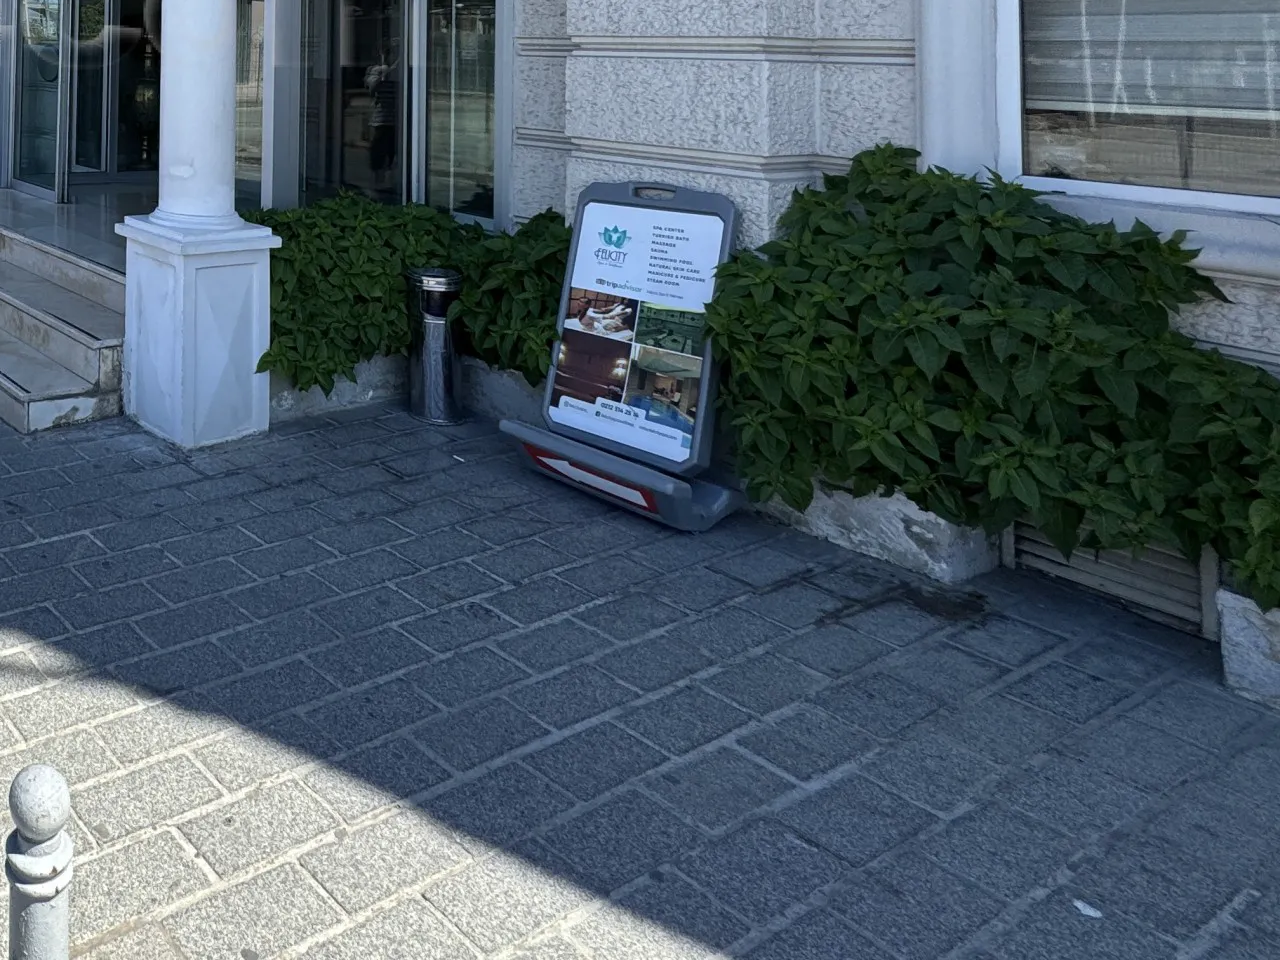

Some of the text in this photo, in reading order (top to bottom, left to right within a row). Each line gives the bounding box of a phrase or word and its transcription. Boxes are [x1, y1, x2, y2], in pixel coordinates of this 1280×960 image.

[648, 262, 672, 270] NATURAL
[647, 270, 674, 278] MANICURE
[680, 275, 706, 283] PEDICURE
[606, 280, 642, 292] tripadvisor
